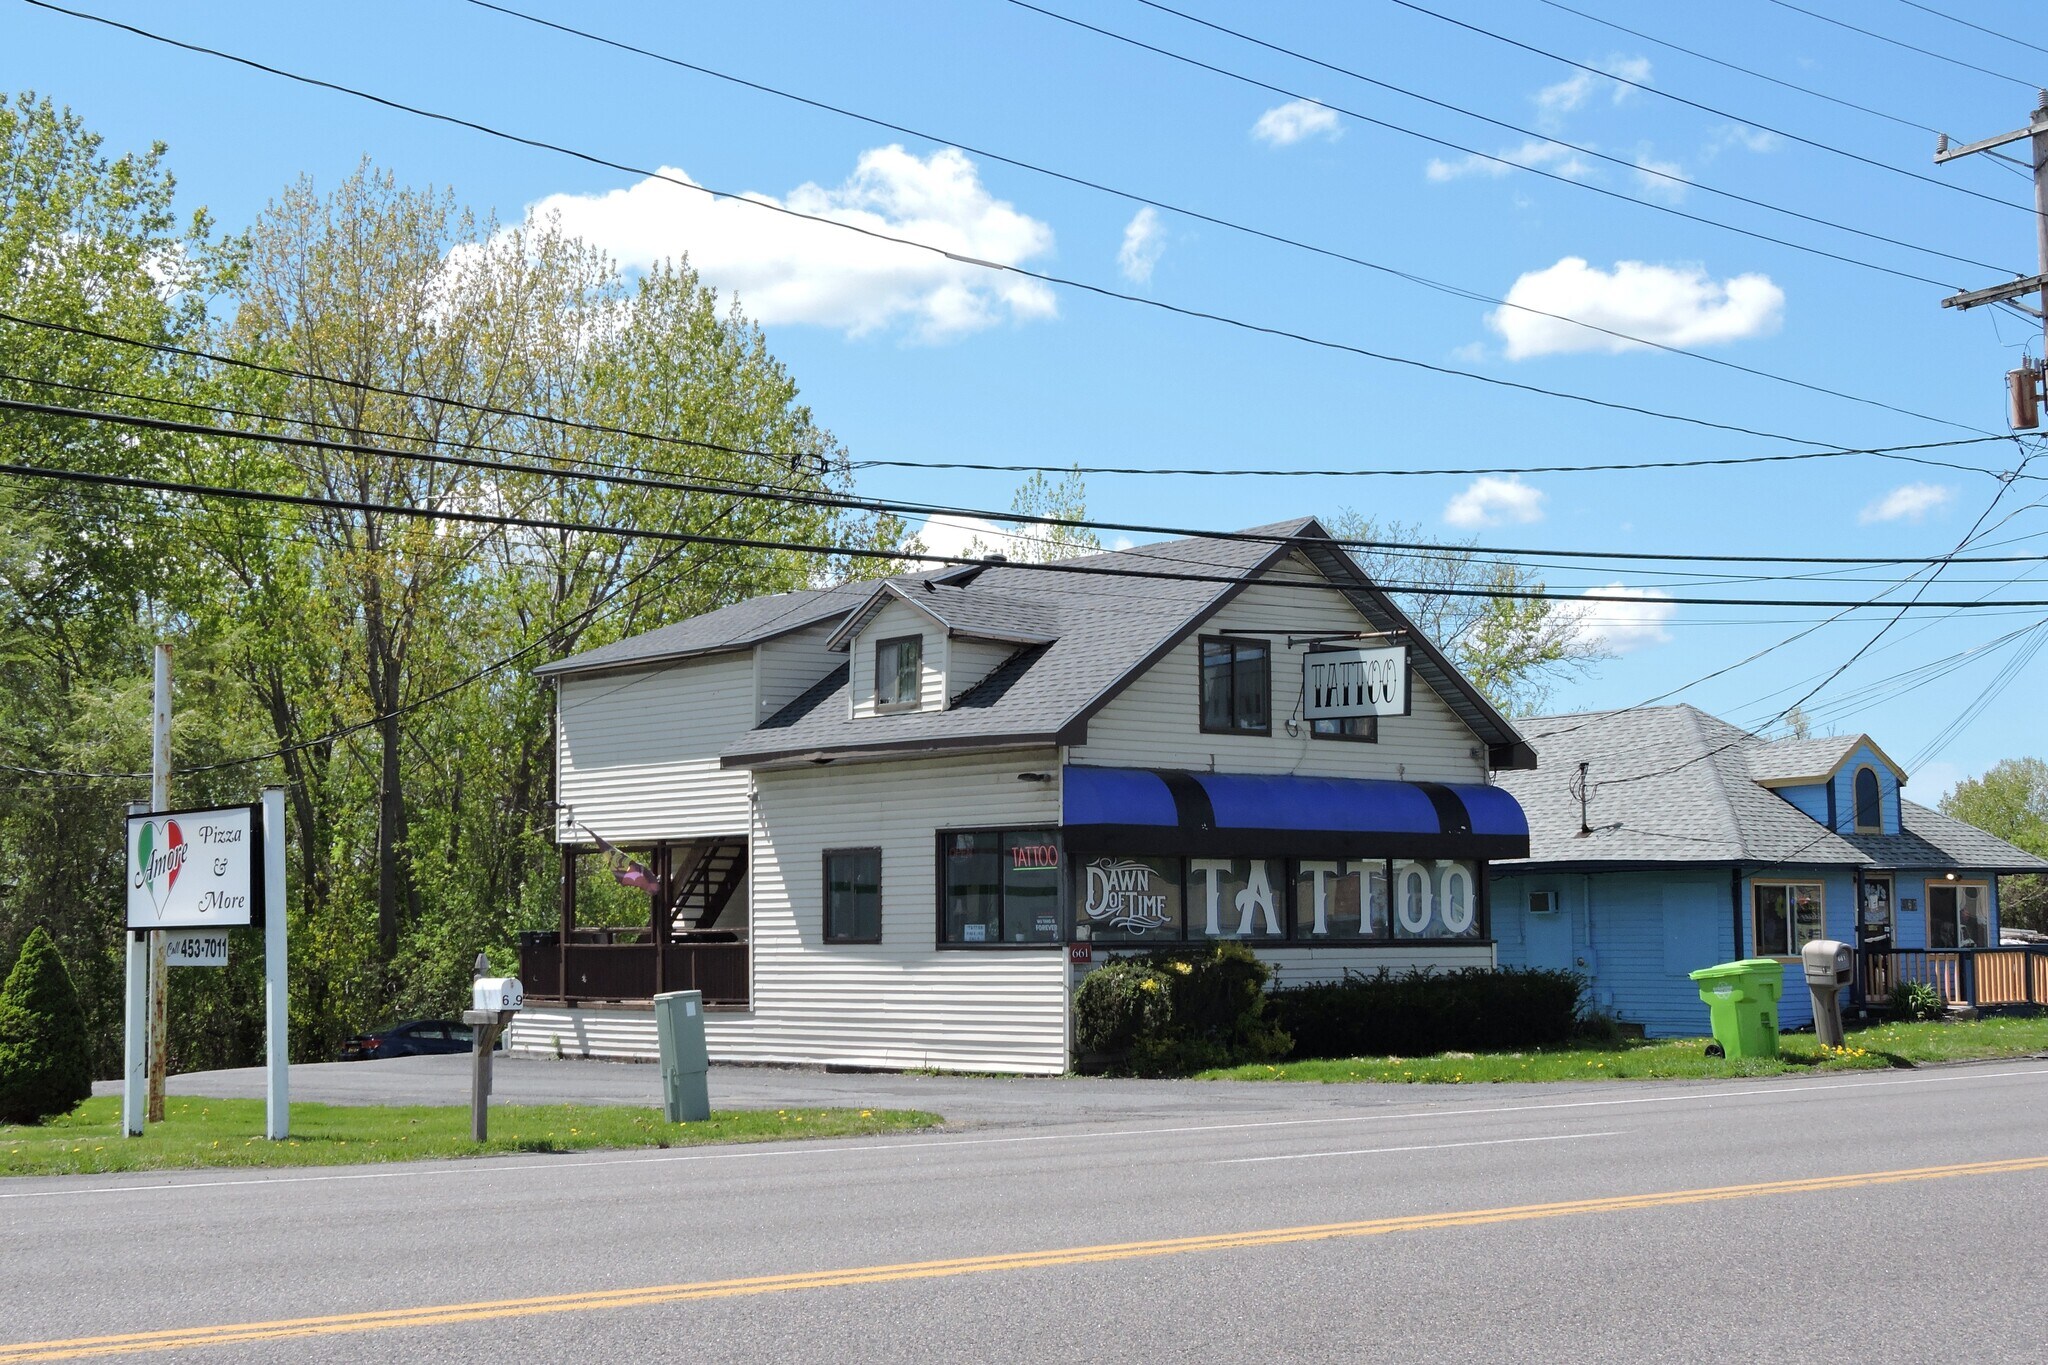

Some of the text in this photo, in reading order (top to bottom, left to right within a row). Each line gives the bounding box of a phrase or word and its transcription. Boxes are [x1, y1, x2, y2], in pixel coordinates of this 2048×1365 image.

[1311, 659, 1396, 708] TATTOO
[199, 825, 242, 844] Pizza
[134, 842, 189, 889] Amore
[213, 858, 229, 876] &
[1012, 845, 1059, 867] TATTOO
[198, 890, 245, 912] More
[1085, 866, 1149, 919] DAWN
[1191, 859, 1477, 934] TATTOO
[1108, 891, 1172, 922] OF TIME
[166, 941, 181, 957] Call
[1072, 947, 1089, 958] 661
